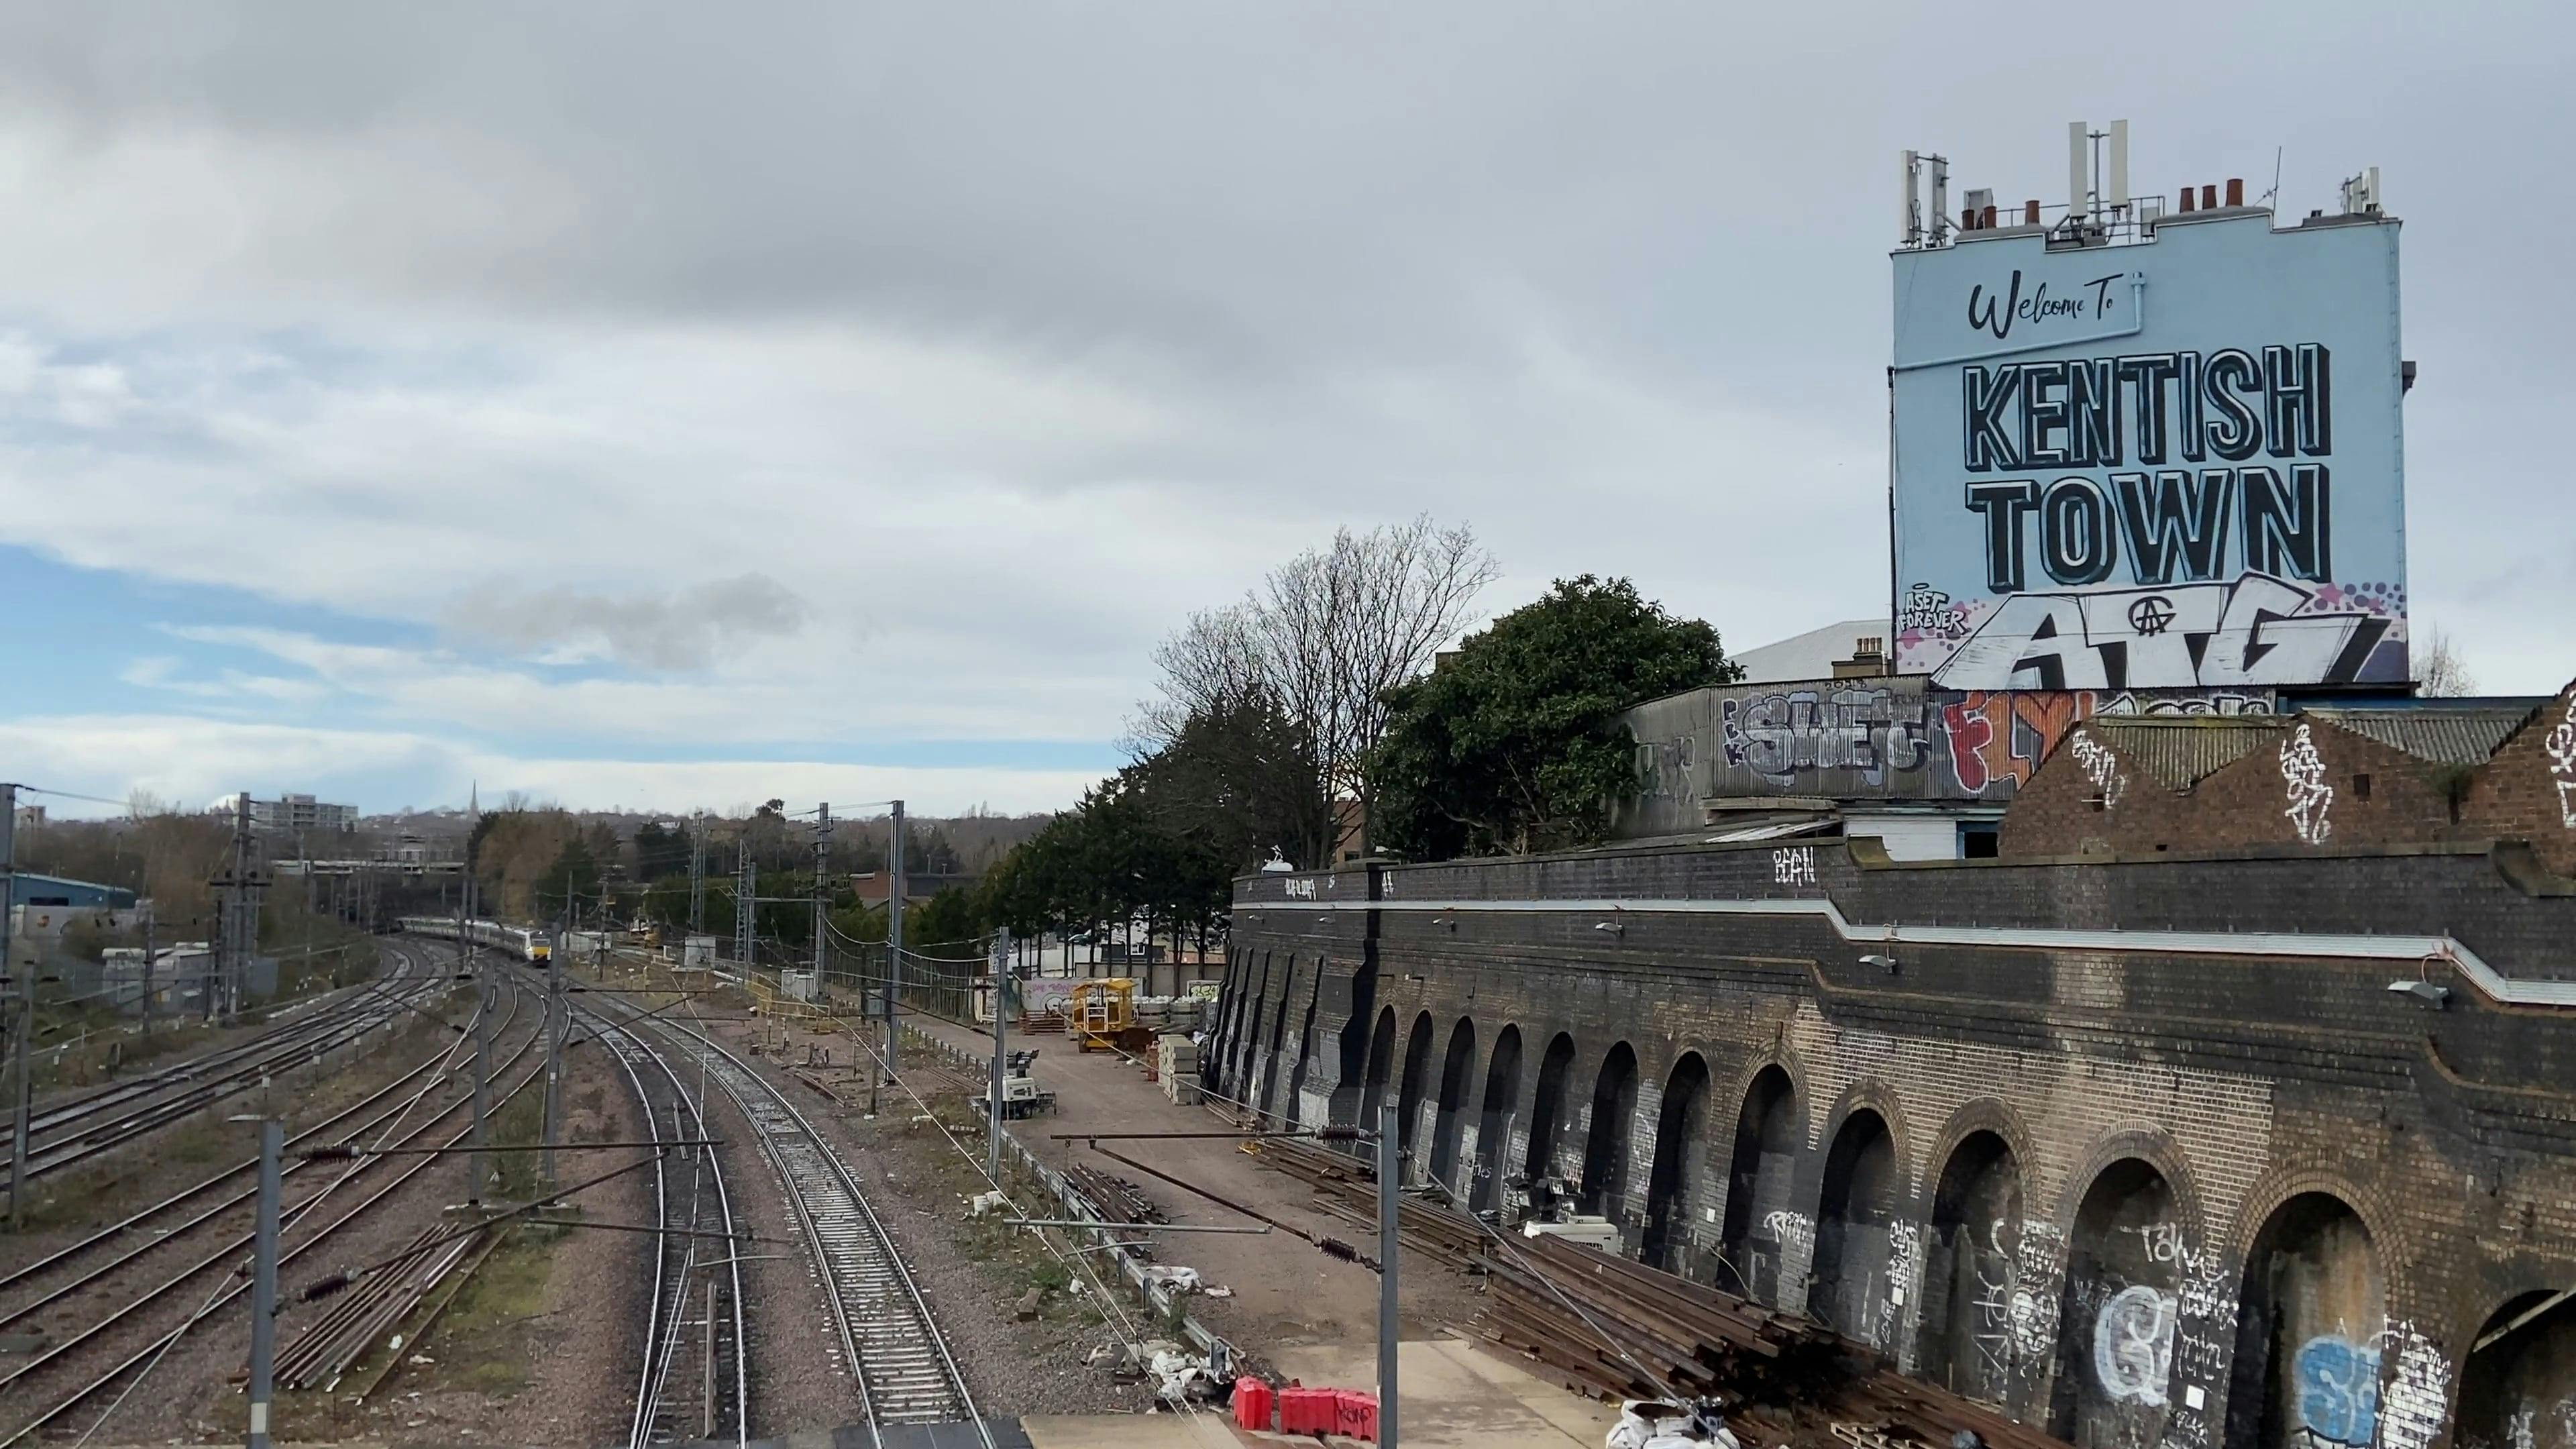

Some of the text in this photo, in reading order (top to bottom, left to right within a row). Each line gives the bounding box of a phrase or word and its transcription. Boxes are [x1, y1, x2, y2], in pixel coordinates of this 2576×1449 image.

[1968, 270, 2124, 339] Welcome To
[1963, 343, 2331, 472] KENTISH
[1964, 464, 2331, 594] TOWN
[1897, 609, 1970, 635] FOREVER
[1904, 590, 1950, 614] ASET
